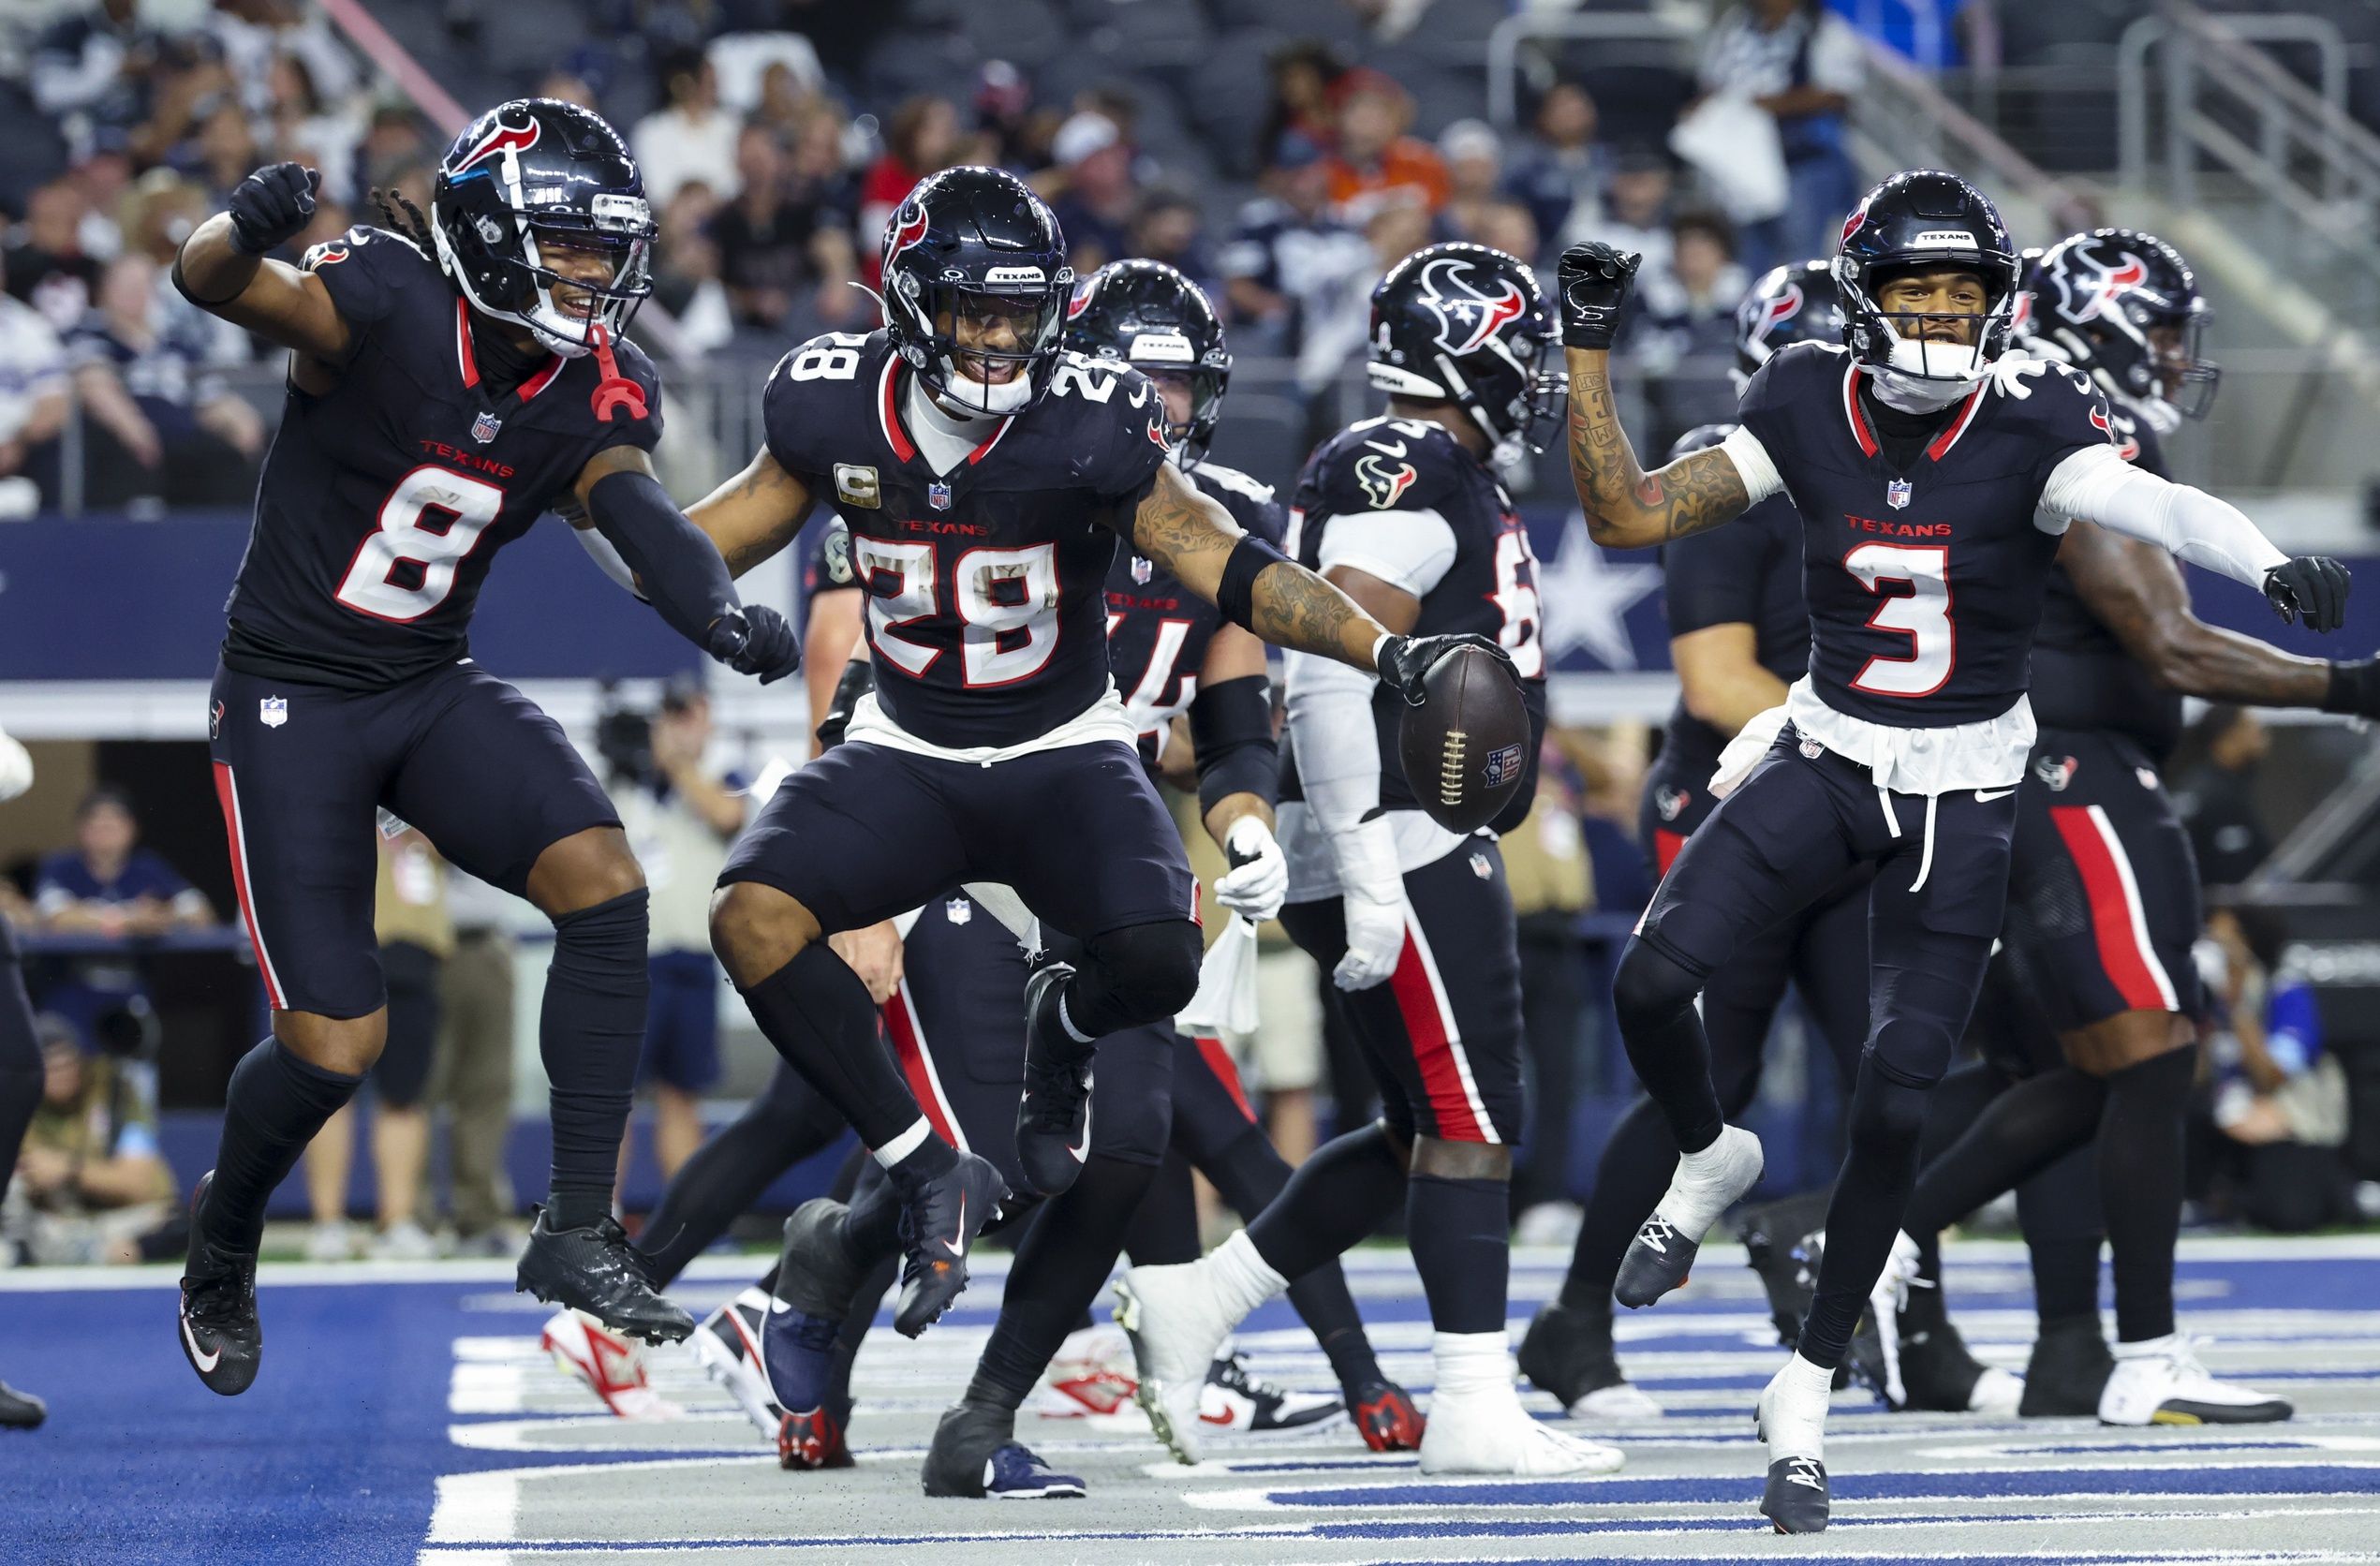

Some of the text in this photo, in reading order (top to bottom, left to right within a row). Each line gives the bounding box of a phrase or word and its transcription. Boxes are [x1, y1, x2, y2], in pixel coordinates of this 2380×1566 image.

[994, 272, 1042, 280] TEXANS
[474, 423, 495, 440] NFL
[419, 438, 516, 479] TEXANS
[836, 466, 876, 498] C
[930, 494, 950, 506] NFL
[1888, 491, 1908, 505] NFL
[897, 519, 989, 537] TEXANS
[1843, 512, 1953, 537] TEXANS
[333, 463, 507, 625] 8
[853, 535, 1063, 689] 28
[1102, 589, 1180, 611] EXANS
[1841, 540, 1957, 699] 3
[1502, 747, 1520, 781] NFL
